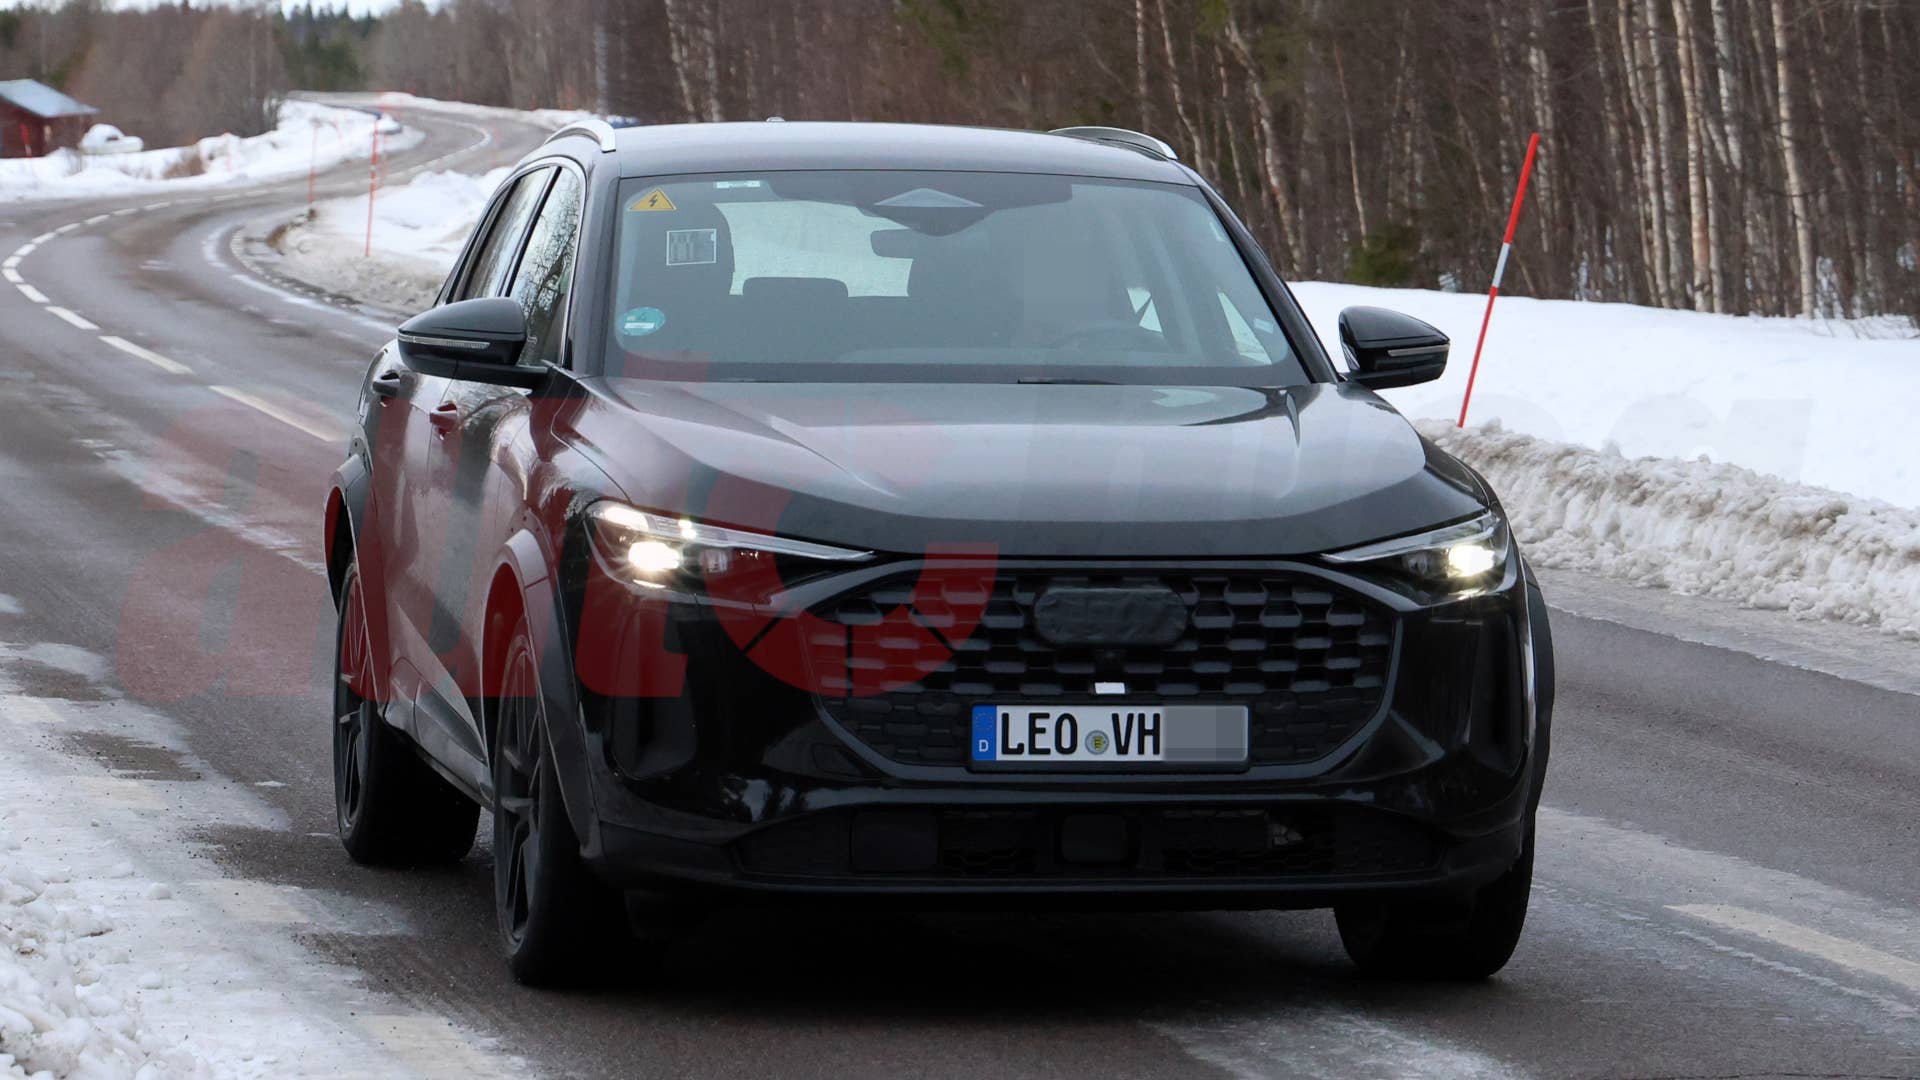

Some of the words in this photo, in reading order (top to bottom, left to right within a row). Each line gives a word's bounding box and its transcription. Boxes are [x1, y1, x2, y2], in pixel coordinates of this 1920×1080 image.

[979, 739, 989, 752] D
[1001, 712, 1078, 755] LEO
[1111, 712, 1161, 755] VH
